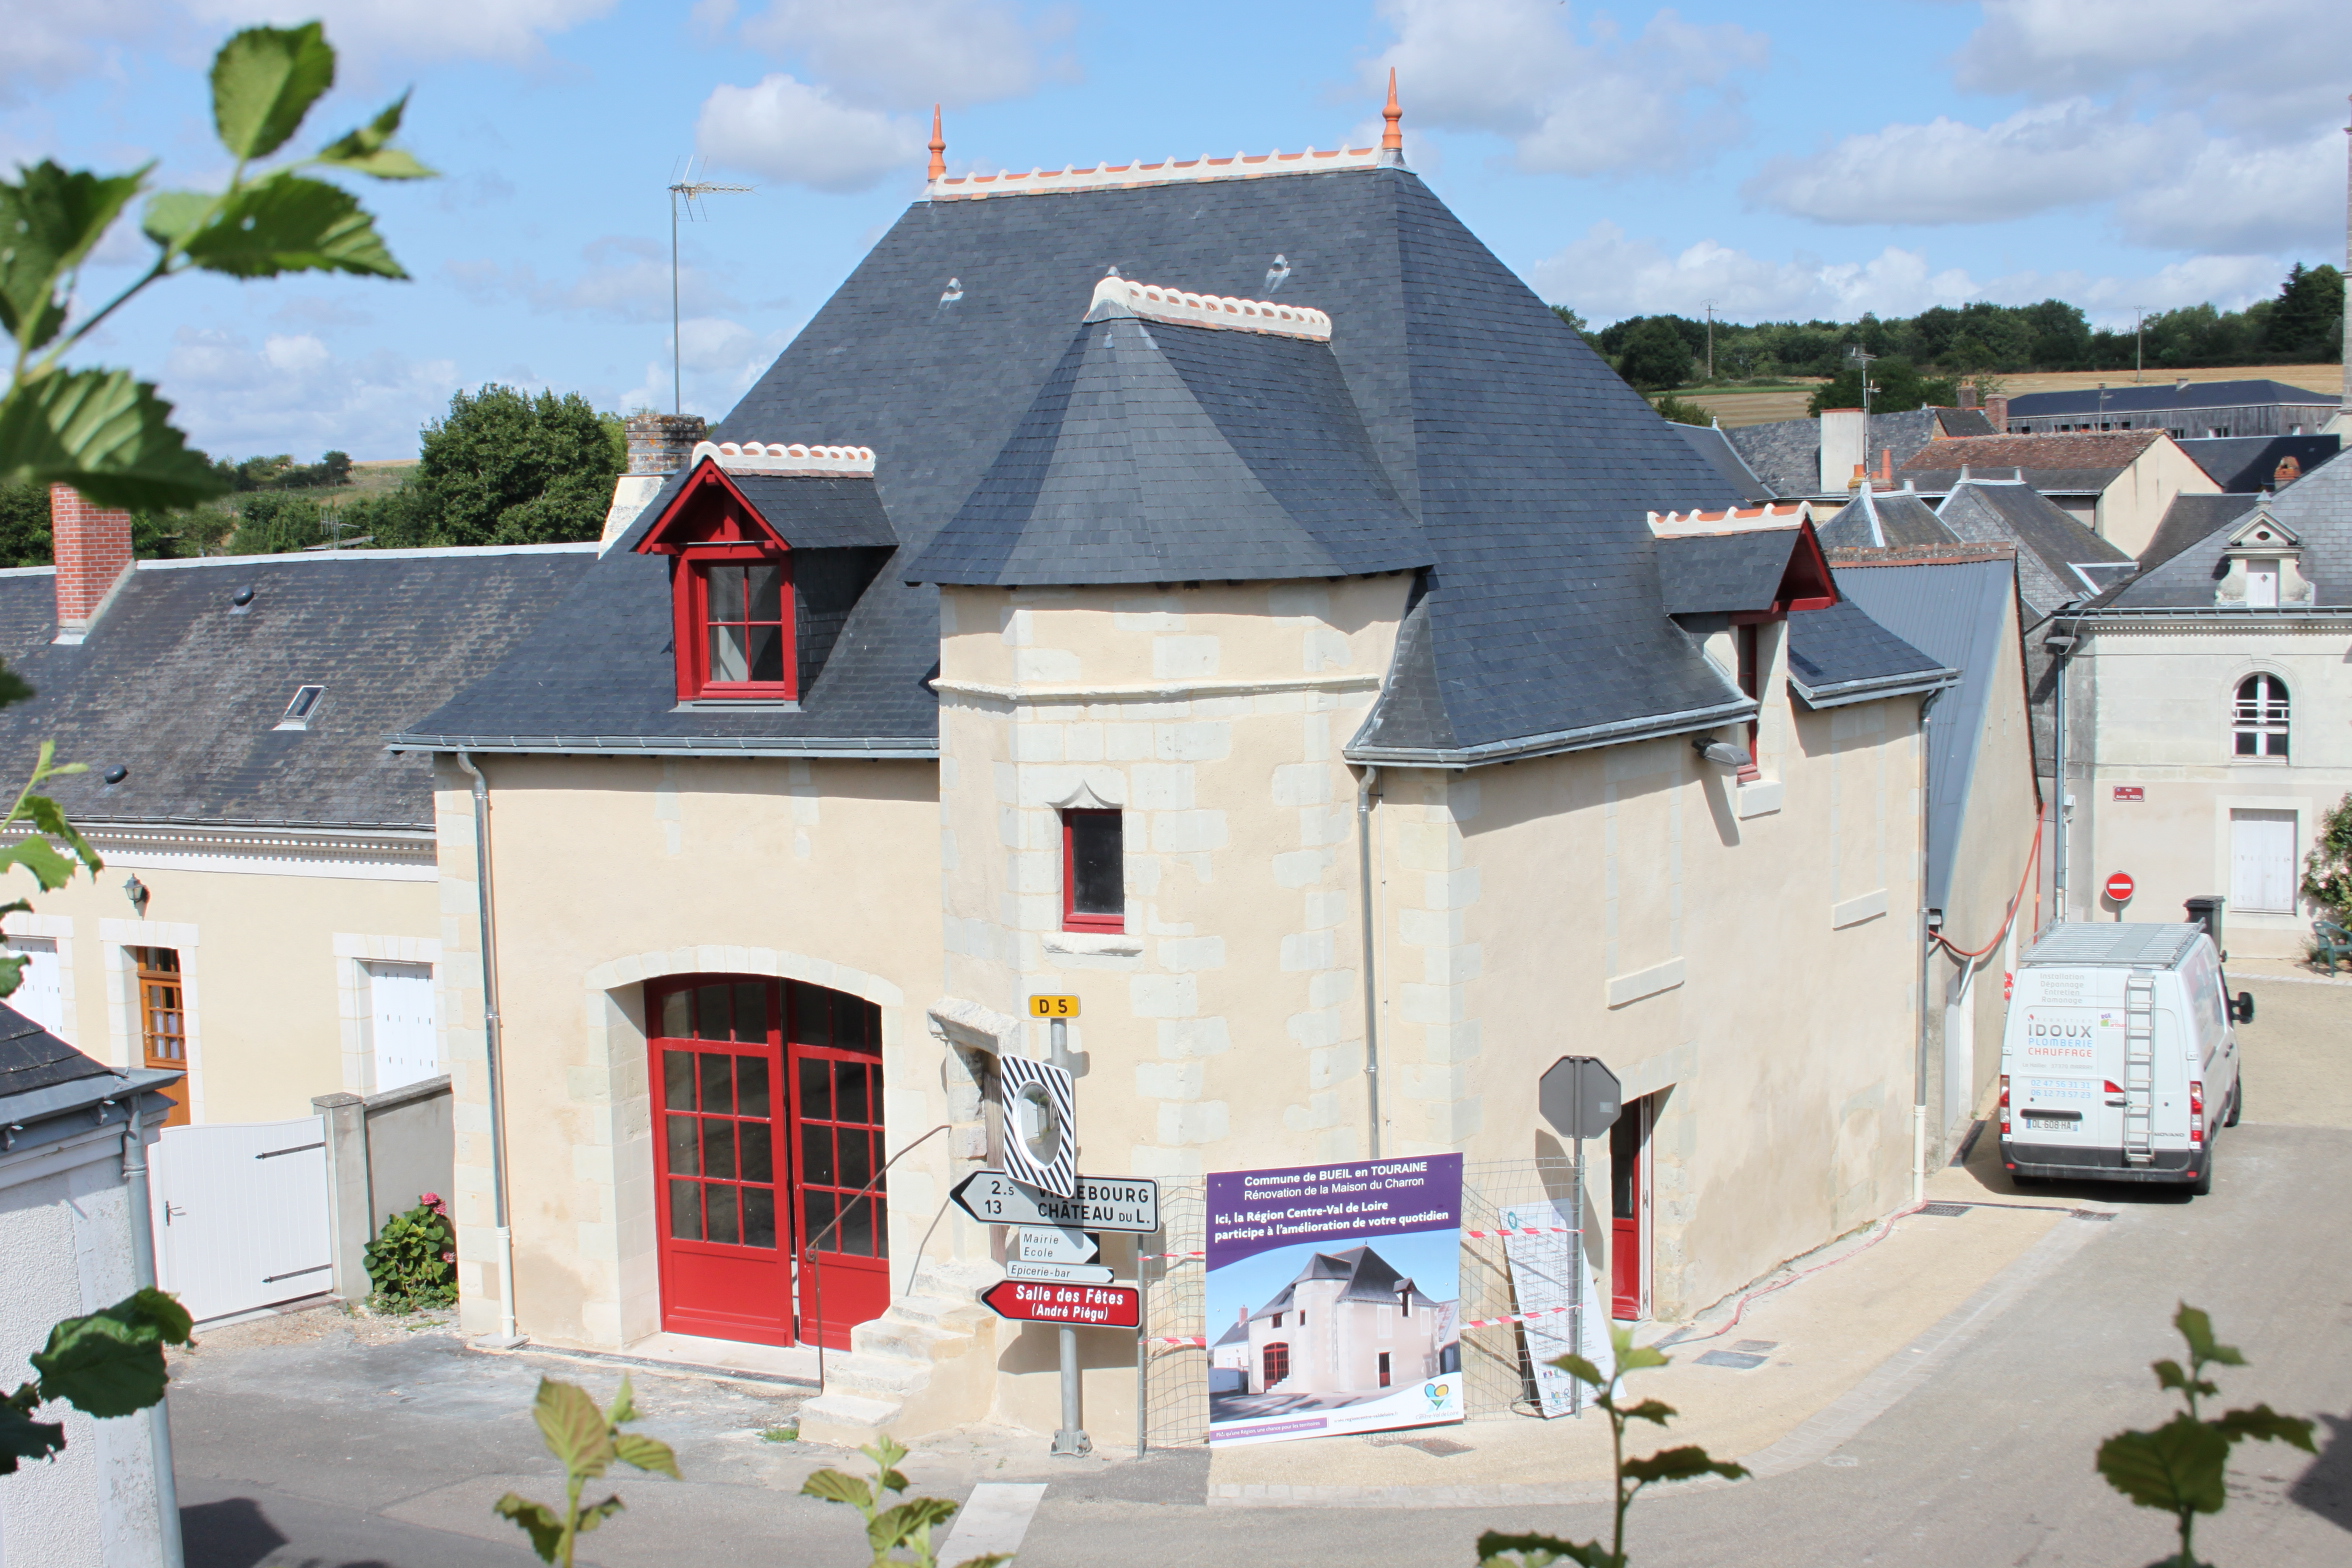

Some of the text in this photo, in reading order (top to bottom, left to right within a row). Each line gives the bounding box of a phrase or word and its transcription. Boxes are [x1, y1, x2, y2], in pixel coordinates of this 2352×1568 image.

[2040, 981, 2084, 989] Dépannage
[1039, 999, 1068, 1014] D 5
[2041, 996, 2083, 1005] Ramonage
[2028, 1023, 2092, 1039] IDOUX
[2028, 1037, 2093, 1048] PLOMBERIE
[2028, 1047, 2093, 1058] CHAUFFAGE
[1244, 1162, 1428, 1187] Commune de BUEIL en TOURAINE
[1039, 1185, 1149, 1203] VEBOURG
[1244, 1177, 1424, 1201] Rénovation de la Maison du Charron
[984, 1200, 1150, 1223] 13 CHÂTEAU DU L.
[1215, 1201, 1388, 1225] Ici, la Région Centre-Val de Loire
[1214, 1227, 1265, 1243] participe
[1267, 1226, 1273, 1236] à
[1352, 1217, 1366, 1228] de
[1368, 1216, 1396, 1226] votre
[1398, 1210, 1449, 1226] quotidien
[1023, 1233, 1059, 1244] Mairie
[1024, 1247, 1053, 1257] Ecole
[1011, 1264, 1071, 1278] Epicerie-bar
[1016, 1285, 1124, 1305] Salle des Fêtes
[1031, 1303, 1109, 1322] (André Piégu)
